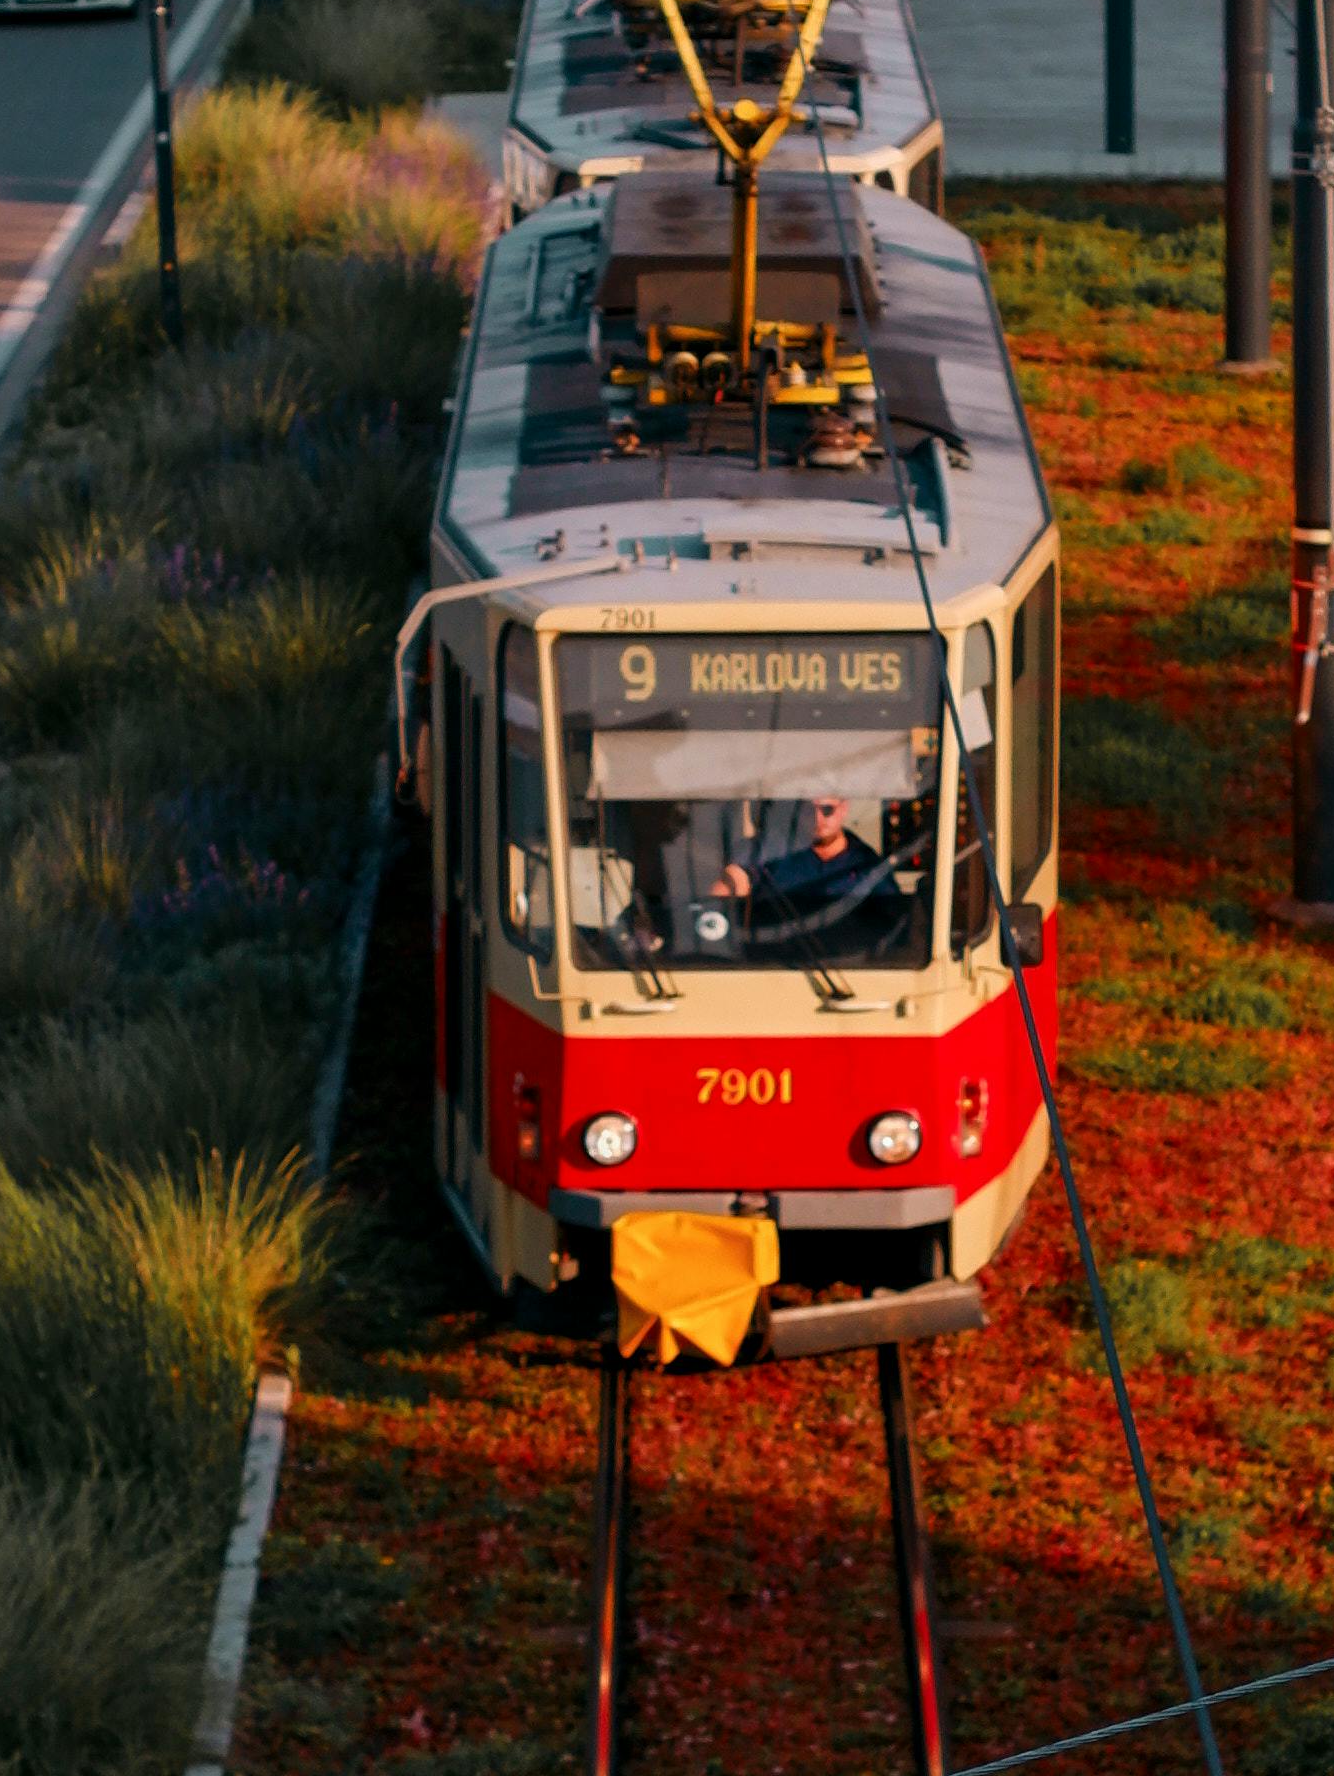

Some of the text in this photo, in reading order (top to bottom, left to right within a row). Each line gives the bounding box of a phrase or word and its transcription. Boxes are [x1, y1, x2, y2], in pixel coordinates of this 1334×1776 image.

[600, 608, 657, 630] 7901
[619, 644, 903, 702] 9 KARLOVA VES
[696, 1067, 792, 1105] 7901
